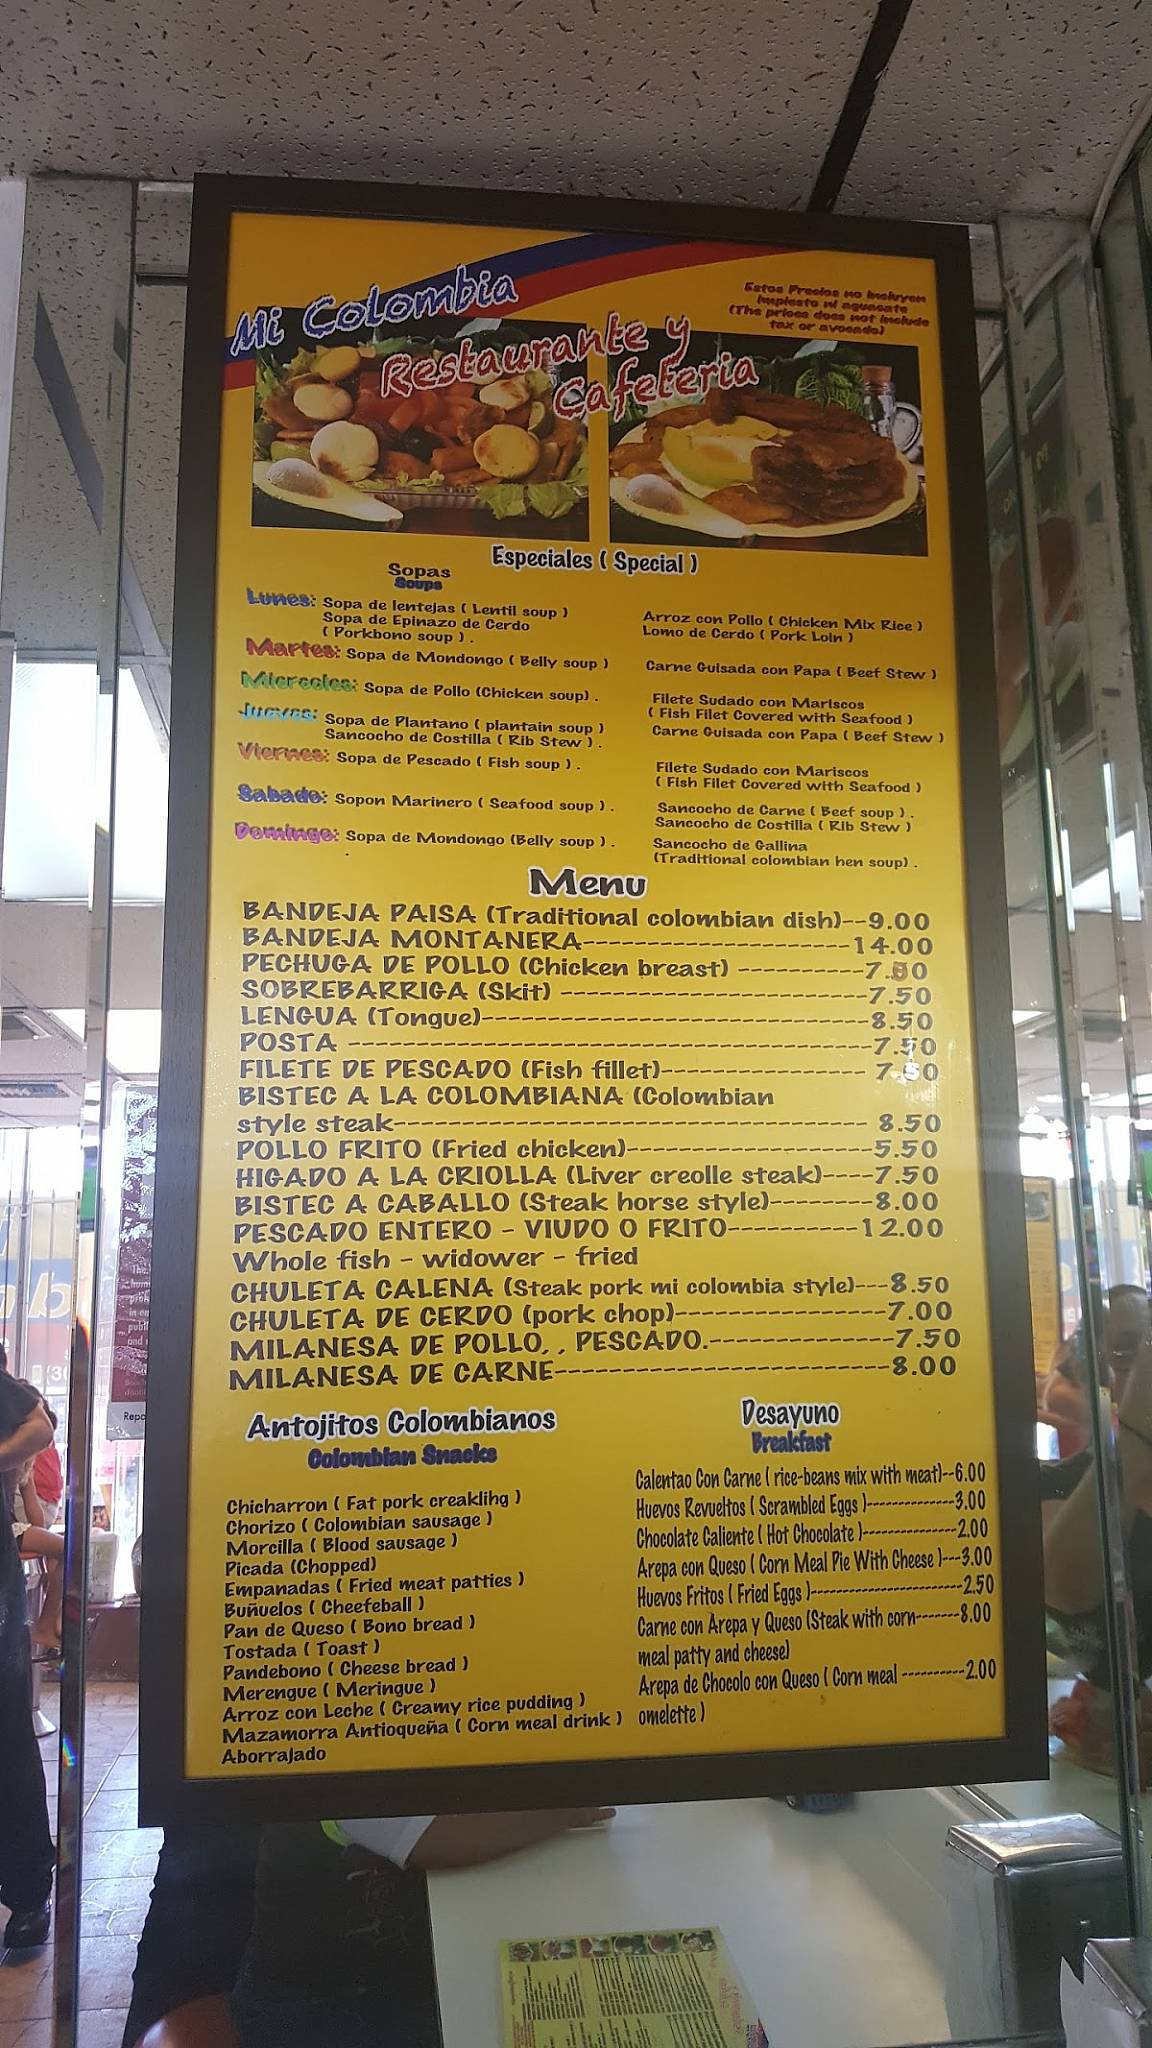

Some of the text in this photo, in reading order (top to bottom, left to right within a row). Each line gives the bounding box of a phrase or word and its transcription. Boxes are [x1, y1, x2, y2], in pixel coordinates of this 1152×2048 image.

[230, 265, 519, 356] Mi Colombia
[814, 310, 845, 321] does
[850, 314, 876, 323] not
[769, 320, 794, 329] tax
[379, 311, 692, 399] Restaurante y
[552, 354, 760, 423] Cafeteria
[388, 563, 450, 579] Sopas
[491, 544, 684, 576] Especiales Special
[393, 578, 443, 592] Soups
[246, 587, 316, 608] Lunes:
[323, 612, 529, 630] Sopa de Epinazo de Cerdo
[245, 638, 341, 658] Martes:
[240, 671, 589, 703] Miercoles: Sopa de Pollo (Chicken soup)
[238, 703, 318, 722] Jueves:
[653, 693, 693, 704] Filete
[699, 695, 754, 706] Sudado
[792, 698, 864, 709] Mariscos
[237, 742, 329, 763] Viernes:
[237, 784, 328, 804] Sabado:
[234, 821, 339, 844] Domingo:
[653, 838, 807, 851] Sancocho de Gallina
[654, 852, 908, 870] (Traditional colombian hen soup)
[528, 866, 648, 899] Menu
[243, 901, 929, 930] BANDEJA PAISA (Traditional colombian dish) 9.00
[243, 928, 932, 955] BANDEJA MONTANERA 14.00
[243, 953, 372, 973] PECHUGA
[384, 955, 415, 974] DE
[426, 956, 509, 974] POLLO
[520, 957, 628, 976] (Chicken
[638, 959, 728, 979] breast)
[241, 980, 931, 1005] SOBREBARRIGA (Skit) 7.50
[241, 1006, 932, 1030] LENGUA (Tongue) 8.50
[241, 1032, 936, 1056] POSTA 7.50
[237, 1139, 937, 1160] POLLO FRITO (Fried chicken) 5.50
[234, 1218, 943, 1244] PESCADO ENTERO VIUDO O FRITO 12.00
[233, 1246, 638, 1272] Whole fish widower fried
[231, 1273, 949, 1303] CHULETA CALENA (Steak pork mi colombia style) 8.50
[230, 1356, 956, 1390] MILANESA DE CARNE 8.00
[245, 1407, 557, 1442] Antojitos Colombianos
[740, 1397, 841, 1429] Desayuno
[751, 1430, 833, 1454] Breakfast
[308, 1443, 498, 1470] Colombian Snacks
[636, 1462, 985, 1490] Calentao Con Carne rice-beans mix with meat) 6.00
[227, 1499, 327, 1514] Chicharron
[347, 1496, 376, 1510] Fat
[383, 1494, 423, 1512] pork
[226, 1556, 376, 1576] Picada (Chopped)
[638, 1574, 994, 1608] Huevos Fritos Fried Eggs 2.50
[225, 1601, 302, 1618] Buñuelos
[638, 1602, 990, 1638] Carne con Arepa y Queso (Steak with corn 8.00
[639, 1639, 789, 1670] meal patty and cheese)
[223, 1712, 610, 1743] Mazamorra Antioqueña Corn meal drink
[222, 1746, 326, 1764] Aborrajado
